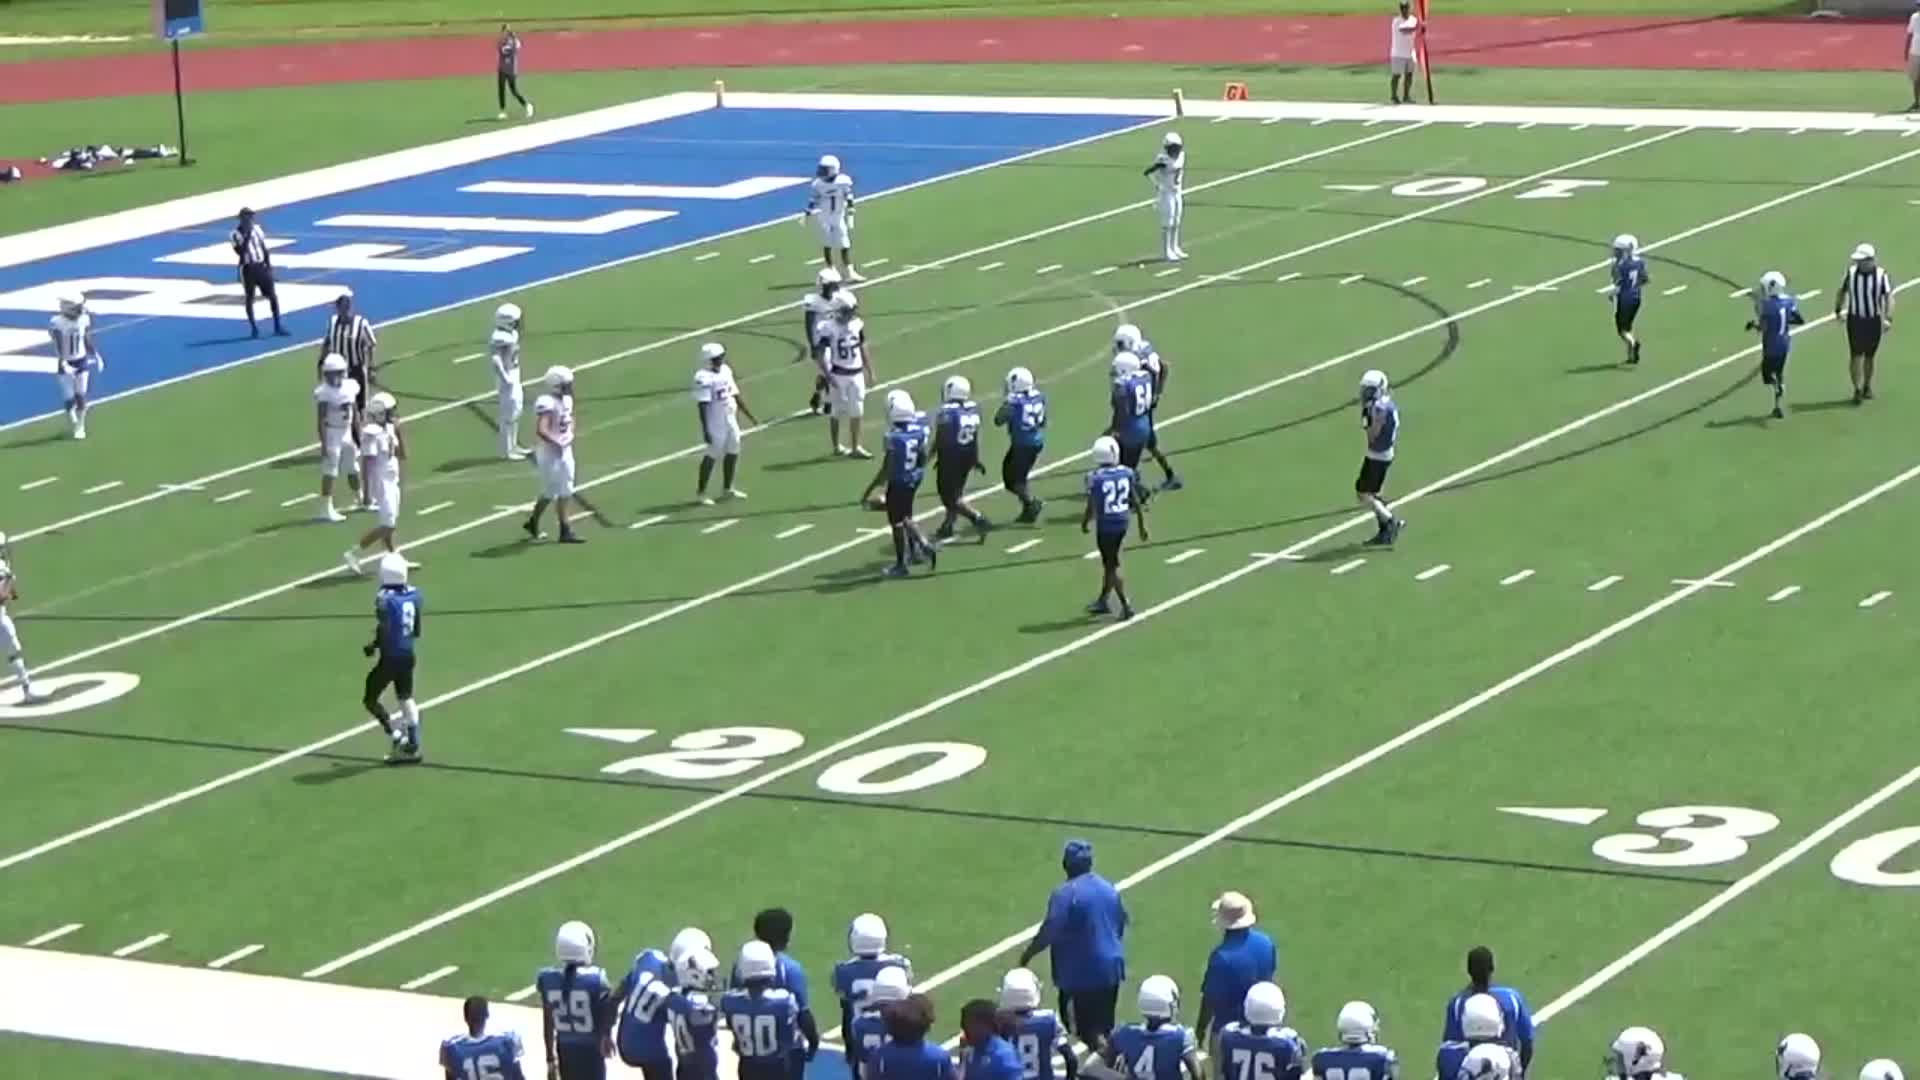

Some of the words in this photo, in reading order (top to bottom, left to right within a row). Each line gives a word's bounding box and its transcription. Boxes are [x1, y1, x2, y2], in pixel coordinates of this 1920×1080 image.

[0, 177, 814, 374] RELL
[1102, 478, 1129, 514] 22
[599, 726, 988, 794] 20
[547, 989, 593, 1033] 29
[626, 971, 671, 1024] 10
[731, 1013, 779, 1057] 80
[1231, 1049, 1276, 1080] 76
